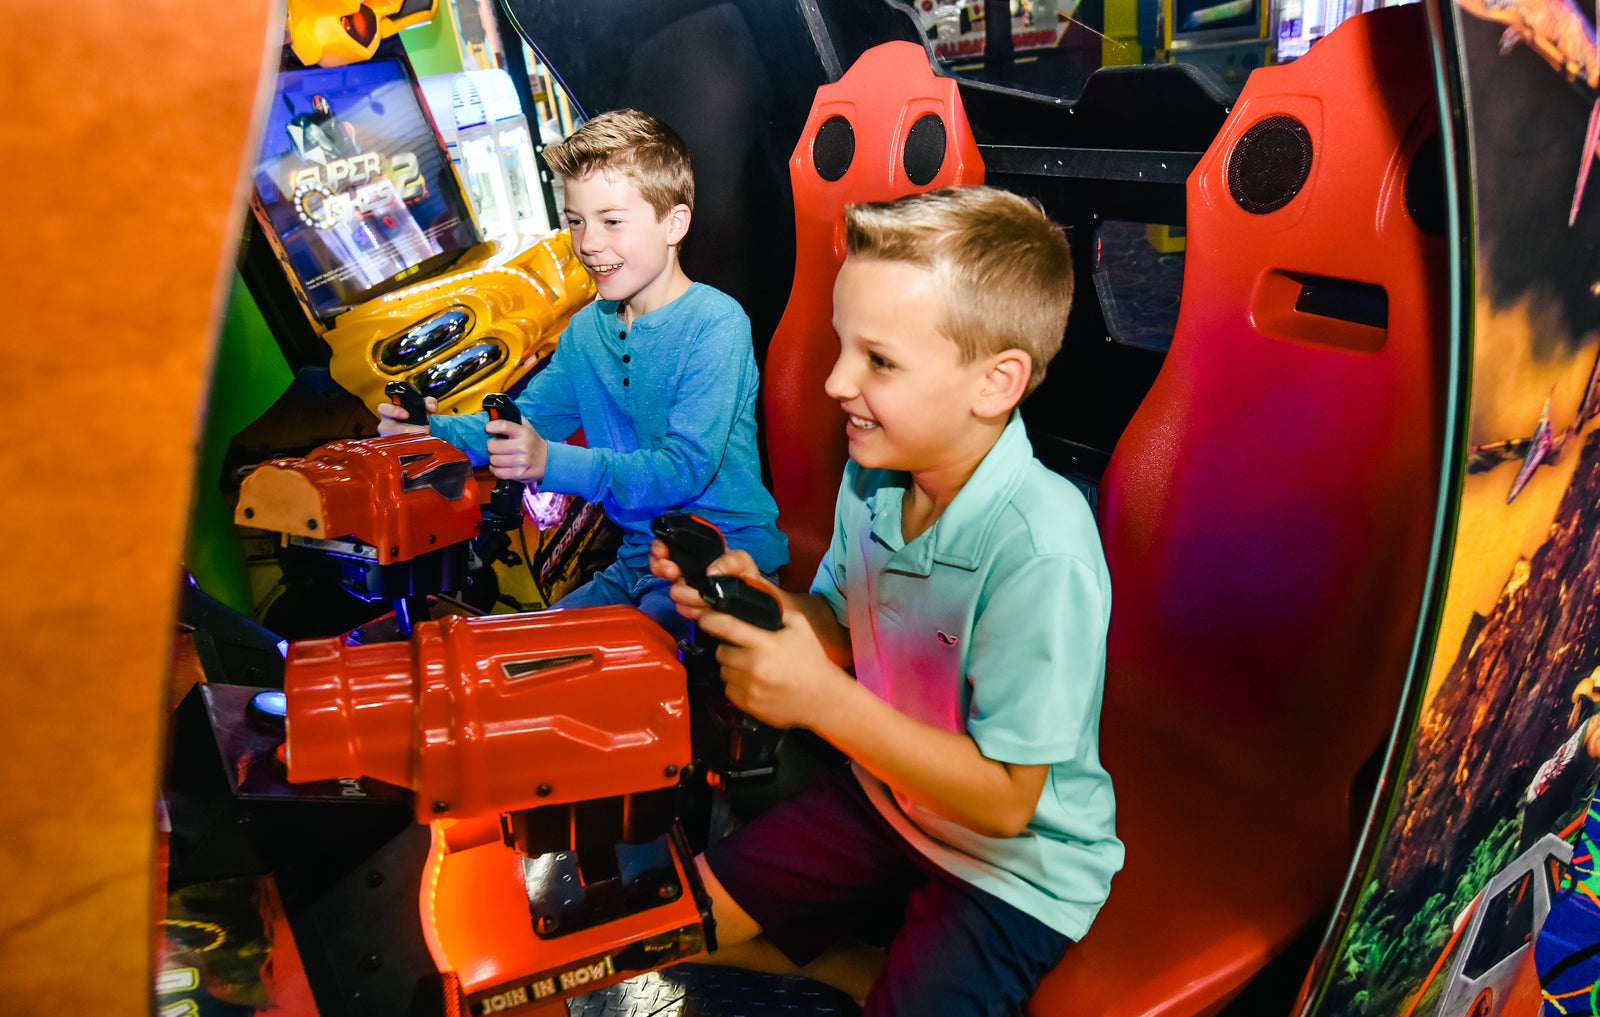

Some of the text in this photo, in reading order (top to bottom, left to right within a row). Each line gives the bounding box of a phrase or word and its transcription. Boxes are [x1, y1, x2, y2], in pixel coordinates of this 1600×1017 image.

[296, 152, 382, 190] SUPER
[391, 152, 423, 199] 2
[482, 955, 615, 1015] JOIN IN NOW!
